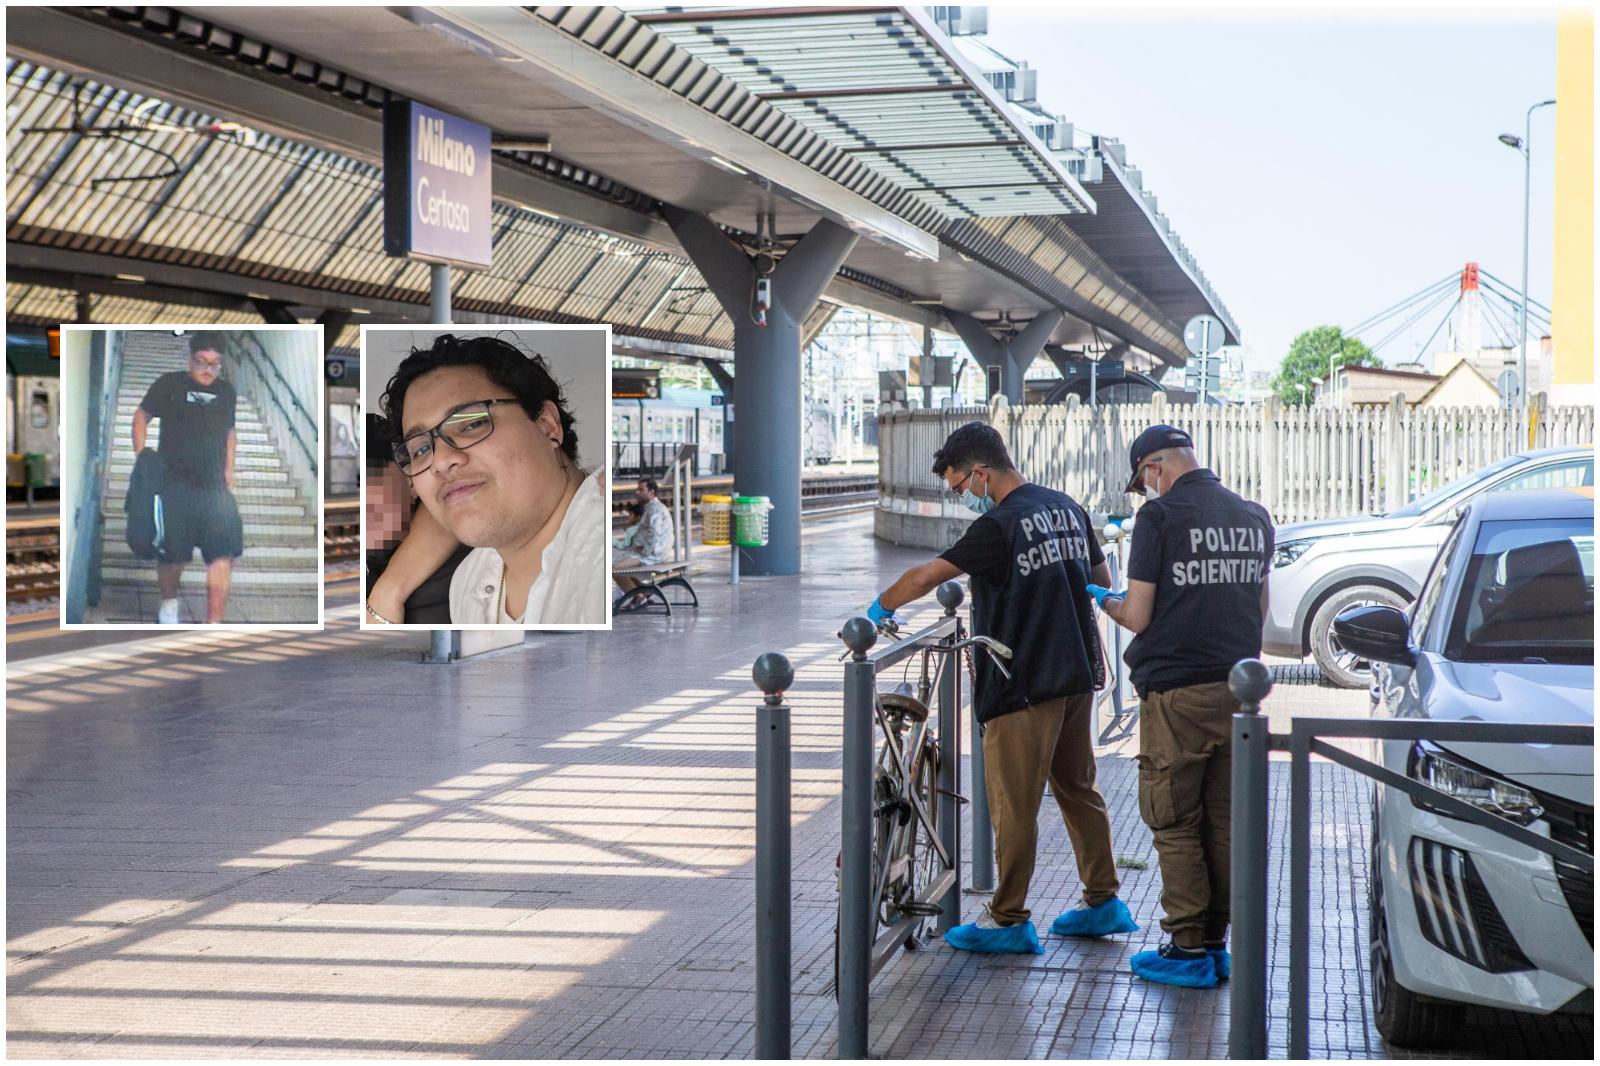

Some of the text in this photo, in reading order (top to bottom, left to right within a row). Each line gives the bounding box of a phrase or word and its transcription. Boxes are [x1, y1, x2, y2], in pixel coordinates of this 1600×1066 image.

[417, 114, 475, 176] Milano
[417, 177, 469, 232] Certosa
[1189, 527, 1264, 553] POLIZIA
